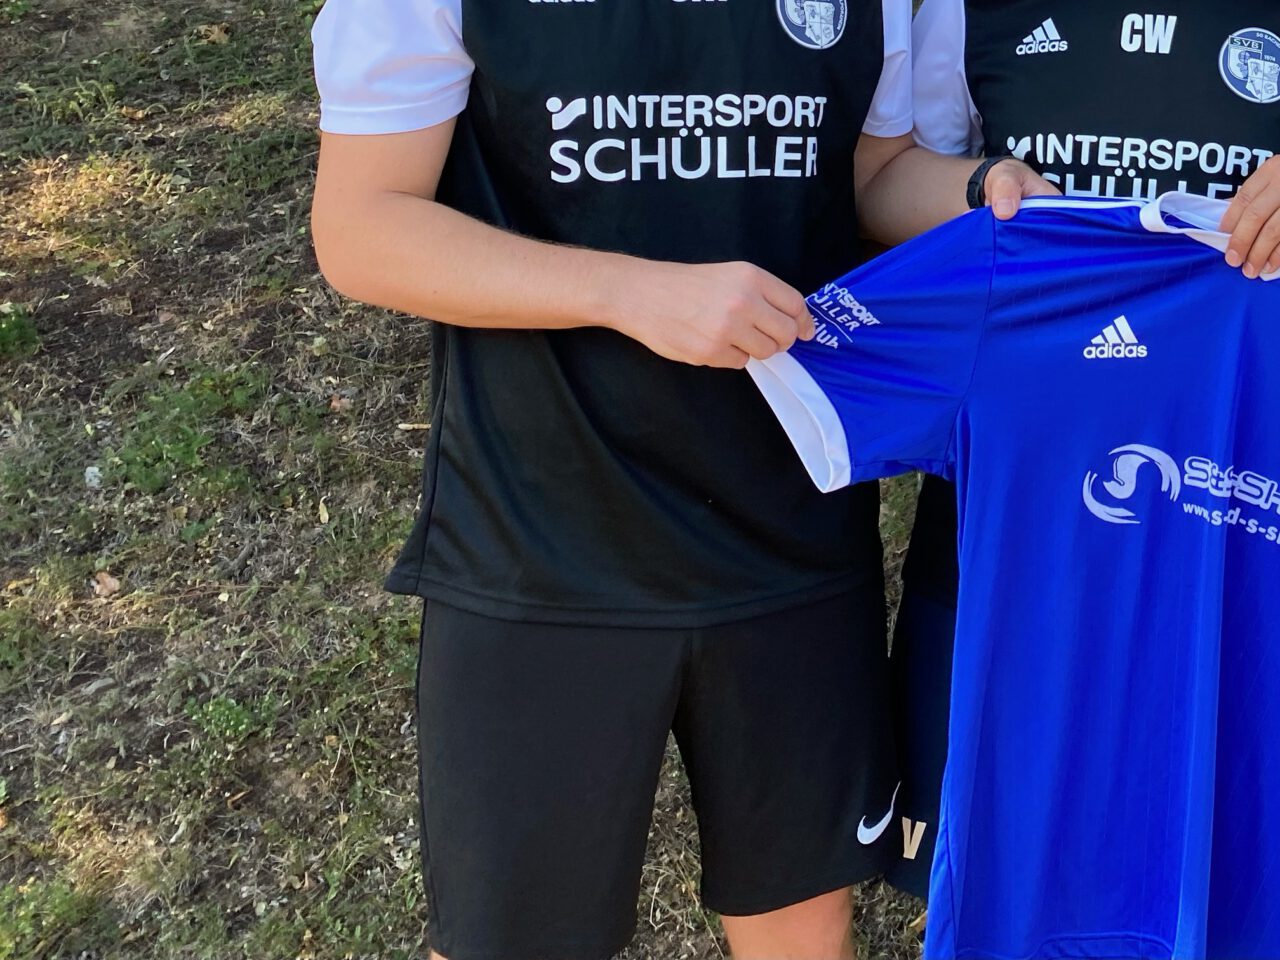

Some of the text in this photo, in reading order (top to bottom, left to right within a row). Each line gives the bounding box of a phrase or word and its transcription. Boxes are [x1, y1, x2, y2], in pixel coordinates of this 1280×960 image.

[1120, 13, 1178, 55] CW
[1233, 38, 1259, 50] SVB
[1016, 39, 1068, 56] adidas
[593, 94, 827, 129] INTERSPORT
[550, 128, 818, 183] SCHÜLLER
[1083, 341, 1148, 358] adidas
